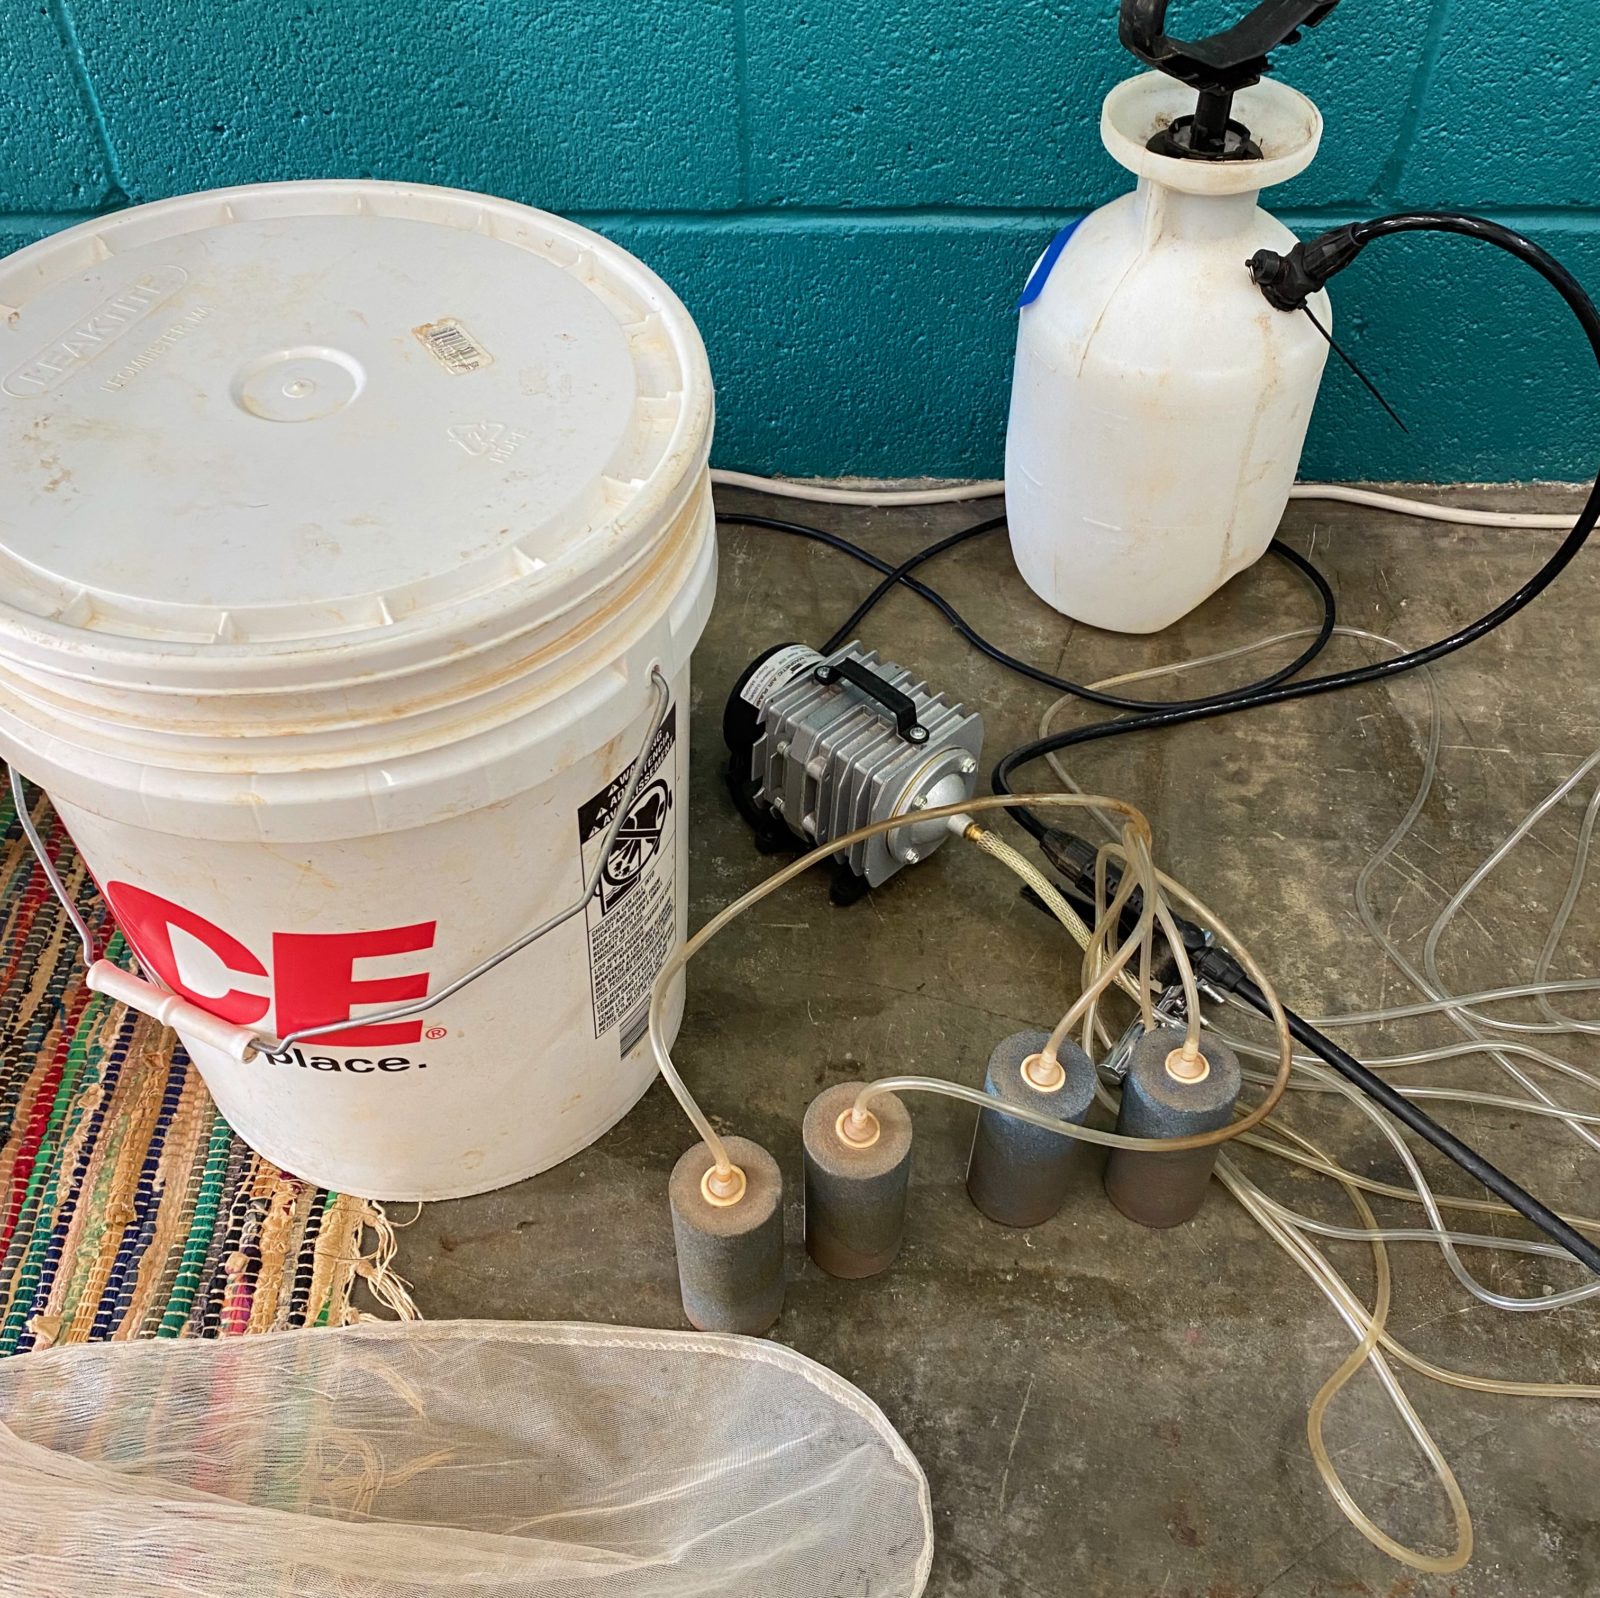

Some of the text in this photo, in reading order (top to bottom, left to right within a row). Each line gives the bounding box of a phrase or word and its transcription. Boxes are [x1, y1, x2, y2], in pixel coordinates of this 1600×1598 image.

[592, 908, 621, 938] CHILDREN
[621, 896, 632, 912] CAN
[592, 922, 614, 944] BUCKET
[615, 909, 627, 925] AND
[593, 935, 607, 952] KEEP
[608, 908, 635, 939] CHILDREN
[593, 932, 619, 958] BUCKETS
[619, 918, 633, 936] WITH
[634, 903, 645, 921] EVEN
[593, 941, 617, 965] AMOUNT
[594, 961, 606, 974] LOS
[625, 923, 643, 948] PUEDEN
[595, 958, 625, 988] MANTENGA
[631, 942, 640, 956] LOS
[595, 963, 612, 981] BALDE
[596, 982, 605, 993] DEL
[608, 965, 624, 984] BALDE
[597, 998, 607, 1009] LES
[609, 979, 628, 1000] JEUNES
[629, 954, 649, 981] ENFANTS
[596, 987, 608, 1000] UNA
[597, 993, 620, 1015] TOMBER
[621, 978, 634, 996] DANS
[598, 1006, 614, 1022] TENIR
[615, 996, 625, 1008] LES
[599, 1017, 616, 1034] PETITE
